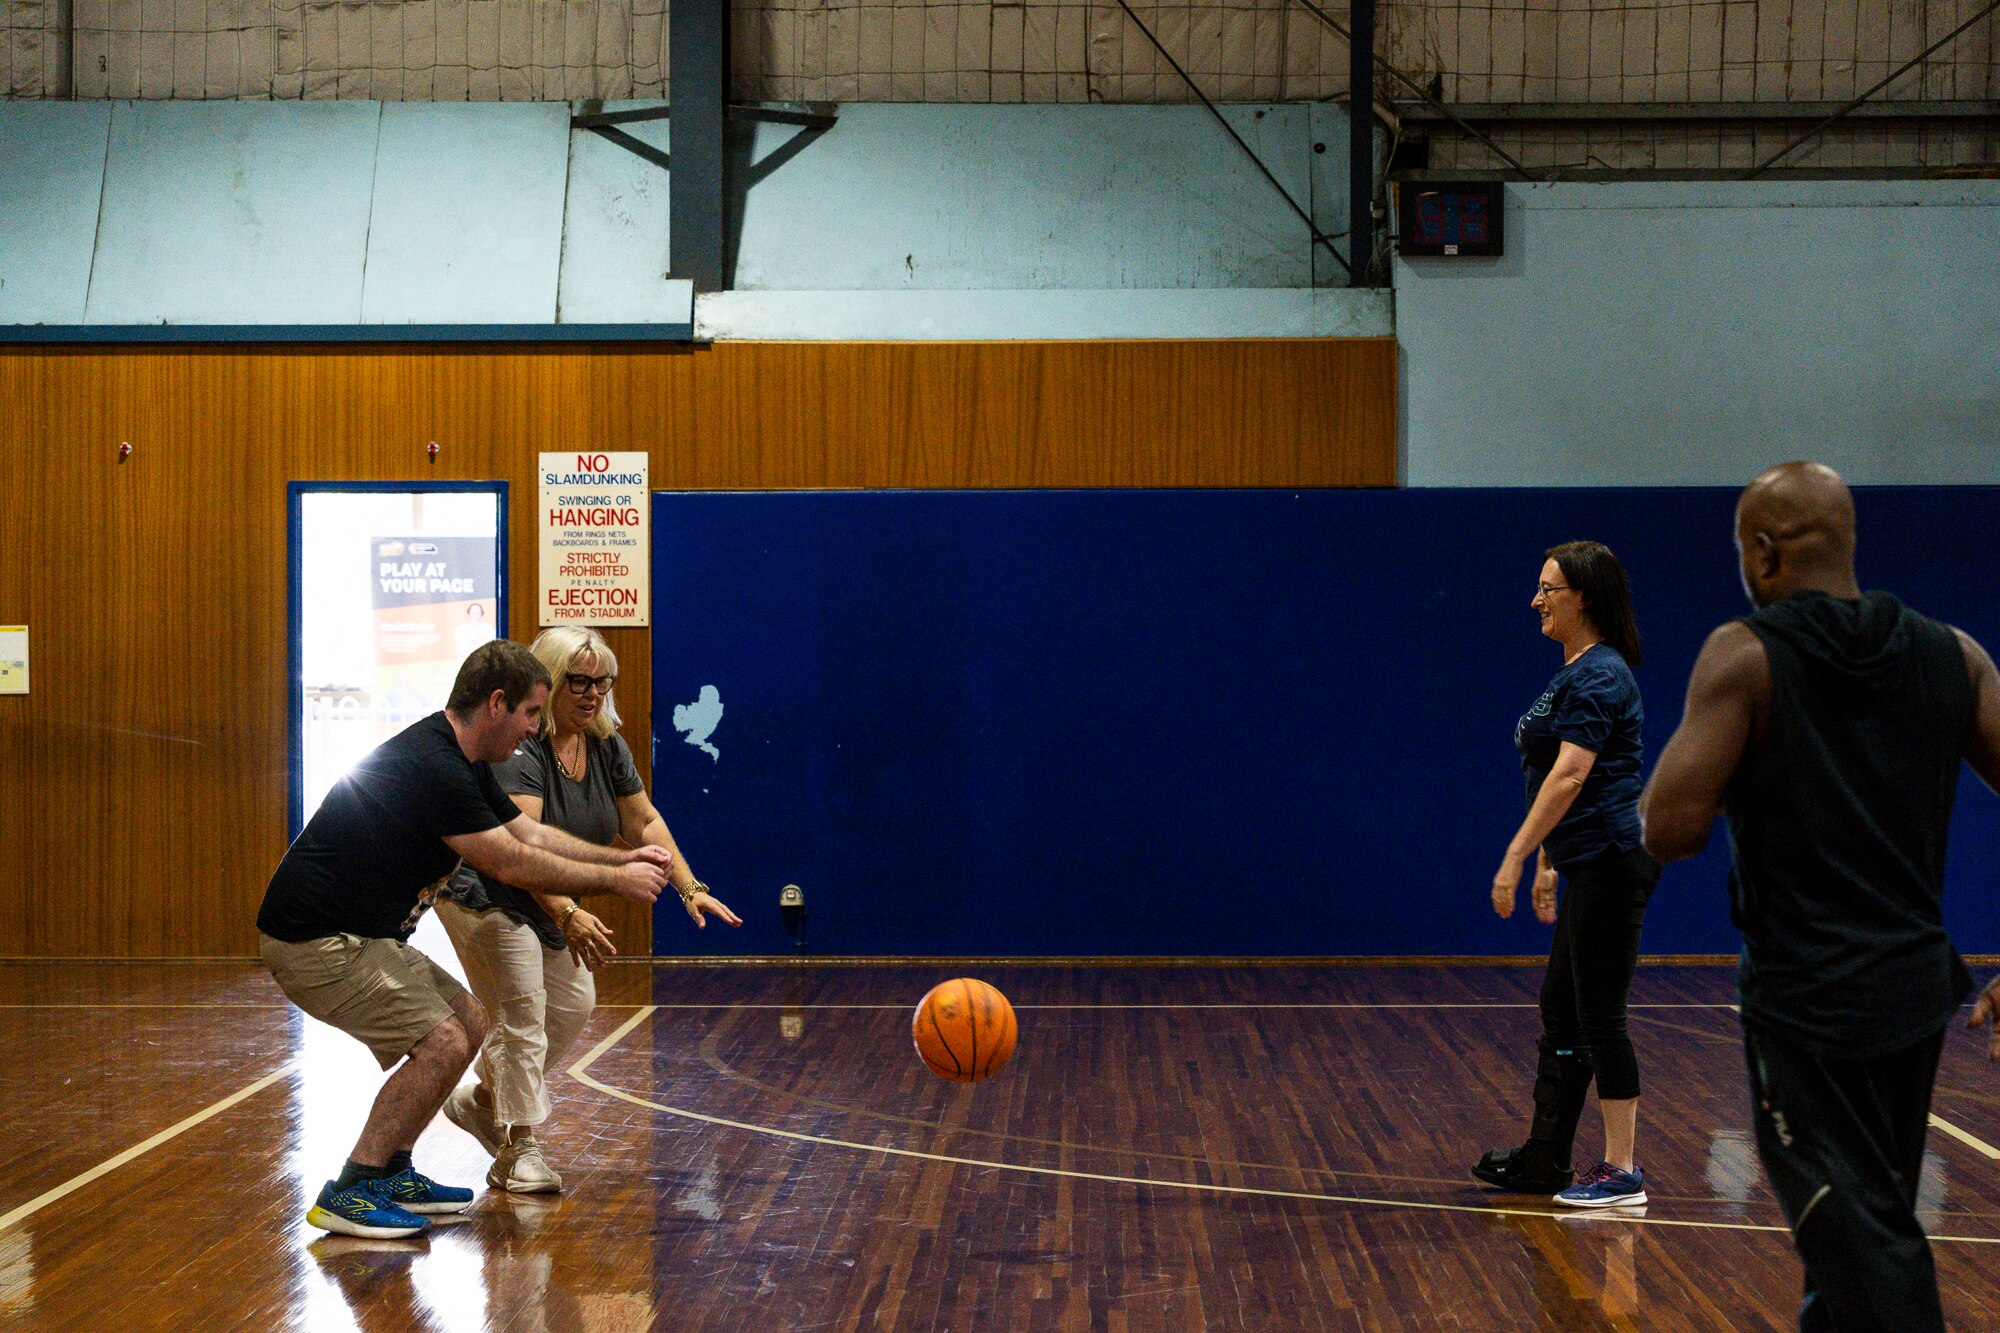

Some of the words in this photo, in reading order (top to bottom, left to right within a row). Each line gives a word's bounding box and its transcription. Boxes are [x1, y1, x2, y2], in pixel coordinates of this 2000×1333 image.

[577, 455, 609, 472] NO
[546, 474, 642, 485] SLAMDUNKING
[559, 496, 611, 506] SWINGING
[616, 496, 631, 505] OR
[550, 509, 639, 526] HANGING
[567, 553, 621, 563] STRICTLY
[380, 563, 422, 577] PLAY
[425, 563, 446, 577] AT
[560, 566, 628, 576] PROHIBITED
[379, 579, 426, 593] YOUR
[430, 579, 474, 593] PACE
[549, 589, 637, 605] EJECTION
[555, 608, 584, 617] FROM
[590, 608, 635, 617] STADIUM
